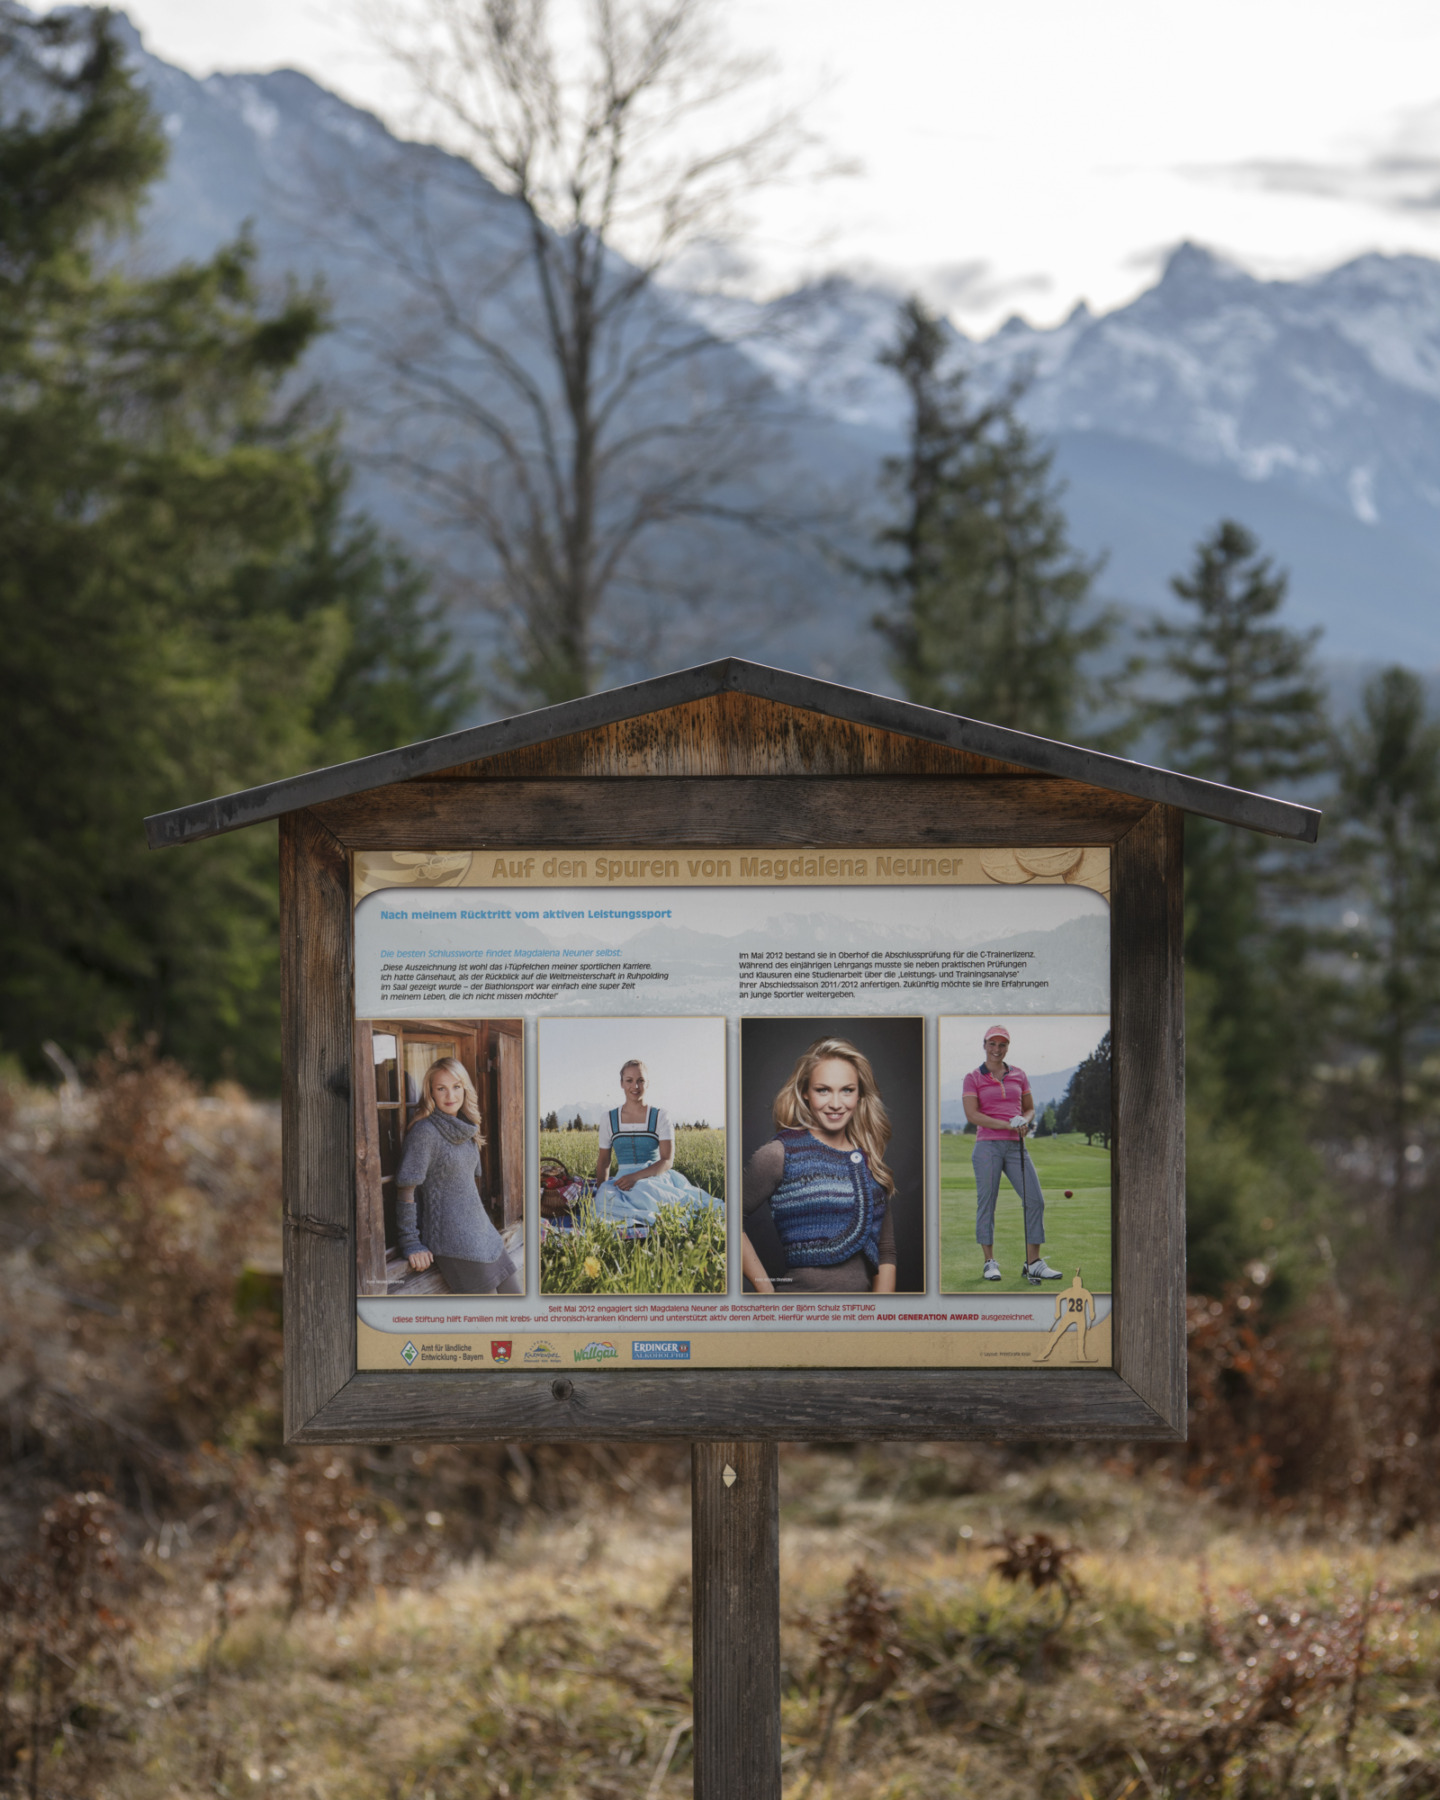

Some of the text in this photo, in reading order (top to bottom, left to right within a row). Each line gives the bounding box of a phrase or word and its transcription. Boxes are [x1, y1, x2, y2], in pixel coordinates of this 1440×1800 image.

[492, 856, 963, 882] Auf den Spuren von Magdalena Neuner
[381, 911, 407, 919] Nach
[412, 911, 456, 919] meinem
[461, 910, 511, 919] Rücktritt
[543, 910, 584, 919] aktiven
[588, 910, 672, 920] Leistungssport
[429, 950, 483, 958] Schlussworte
[514, 949, 560, 958] Magdalena
[885, 951, 951, 959] Abschlussprüfung
[860, 981, 901, 989] anfertigen.
[1068, 1298, 1084, 1313] 28
[634, 1342, 678, 1352] ERDINGER
[422, 1353, 457, 1362] Entwicklung
[463, 1353, 483, 1362] Bayern
[574, 1346, 618, 1362] Wallgau
